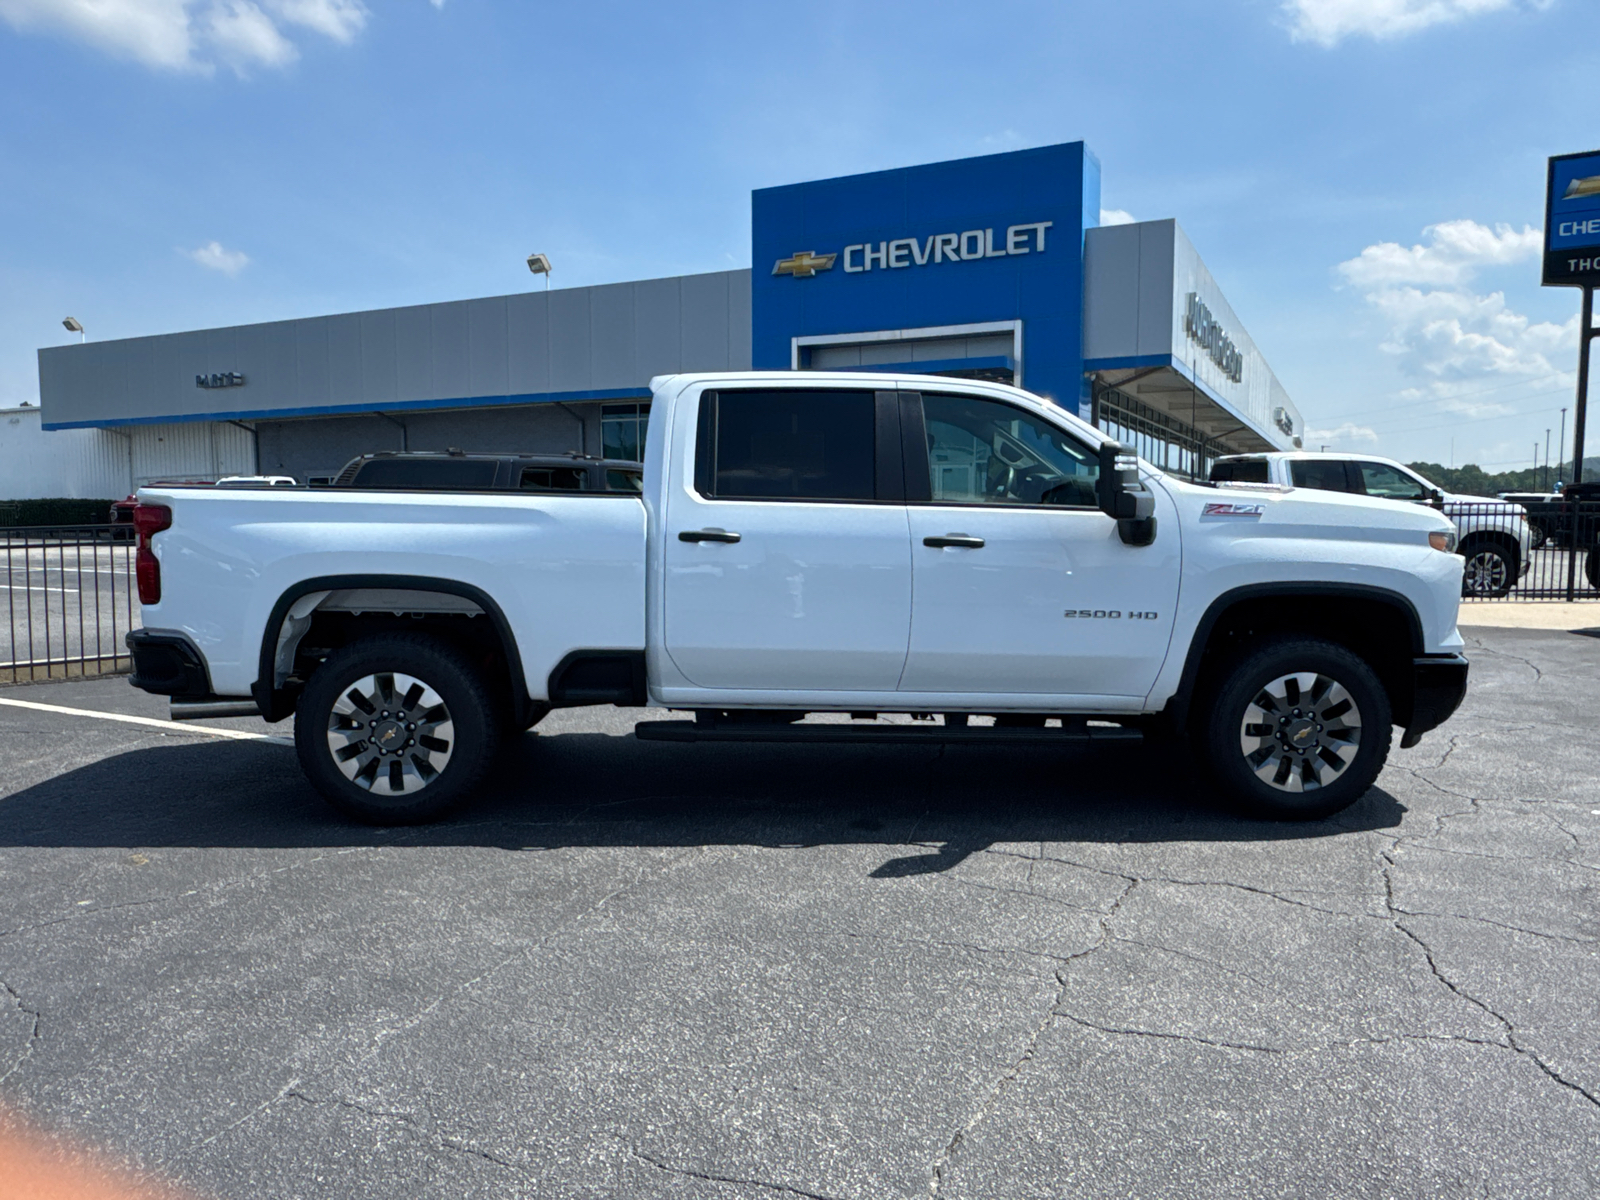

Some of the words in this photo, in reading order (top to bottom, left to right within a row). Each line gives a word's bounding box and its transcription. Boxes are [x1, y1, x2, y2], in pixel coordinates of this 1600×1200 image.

[843, 221, 1053, 273] CHEVROLET
[1063, 609, 1122, 619] 2500
[1127, 611, 1159, 620] HD
